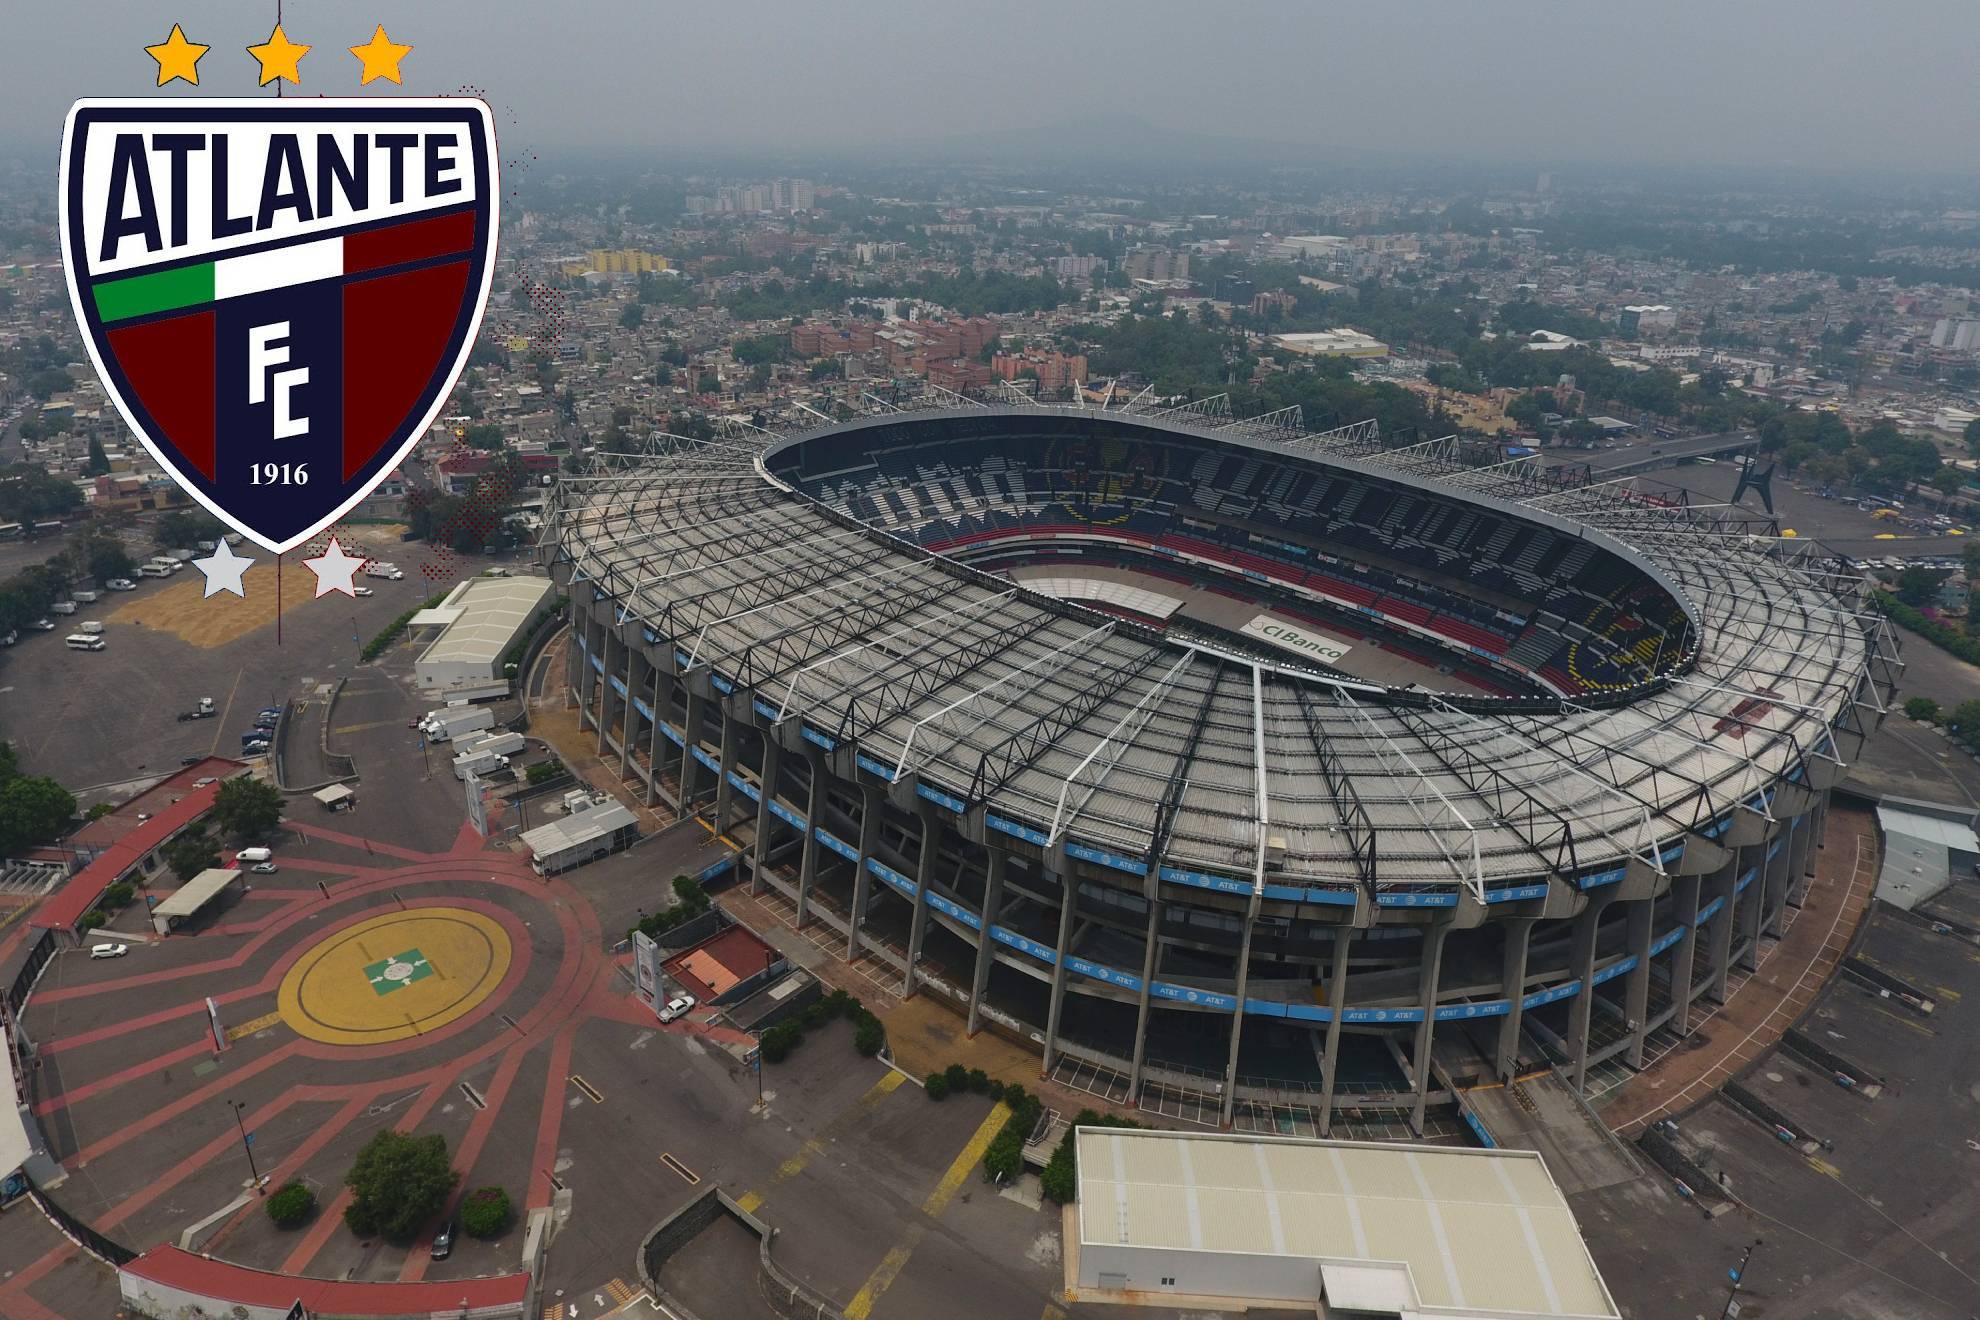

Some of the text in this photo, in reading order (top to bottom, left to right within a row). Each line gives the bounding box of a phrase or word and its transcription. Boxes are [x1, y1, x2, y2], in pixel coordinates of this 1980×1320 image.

[993, 820, 1010, 831] AT&T
[1074, 849, 1137, 871] AT&T AT&T
[1170, 872, 1240, 891] AT&T AT&T
[1601, 873, 1618, 882] AT&T
[1376, 896, 1445, 904] AT&T AT&T
[1519, 888, 1539, 897] AT&T
[932, 898, 977, 926] AT&T AT&T
[998, 932, 1050, 958] AT&T AT&T
[1073, 962, 1134, 985] AT&T AT&T
[1160, 987, 1225, 1005] AT&T AT&T
[1348, 1011, 1414, 1020] AT&T AT&T
[1440, 1005, 1501, 1017] AT&T AT&T
